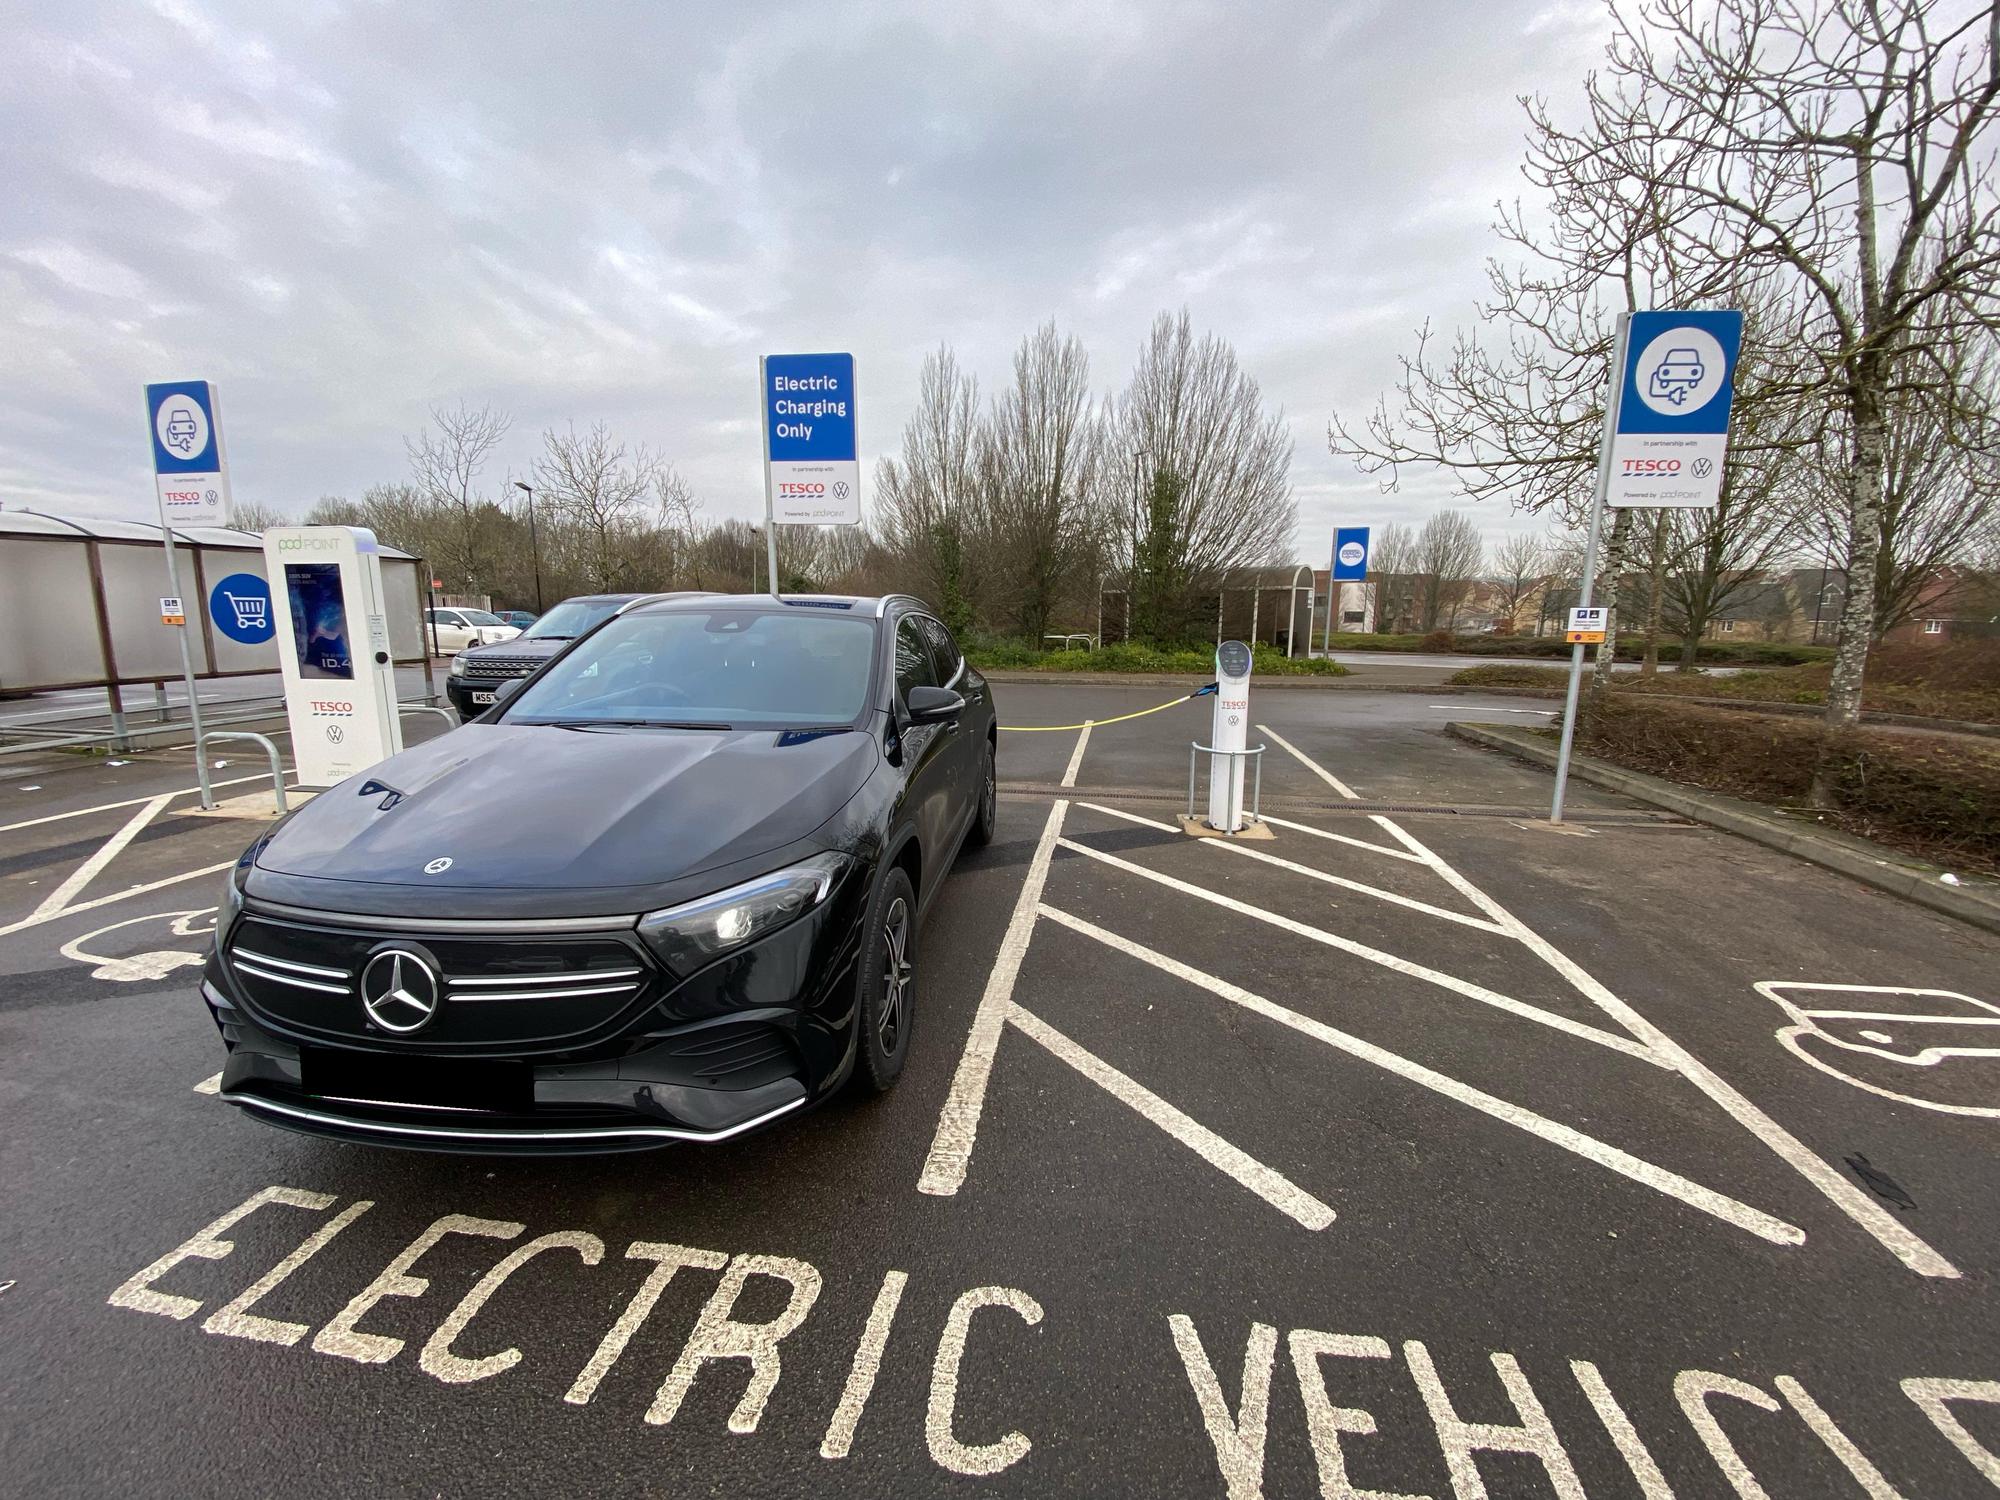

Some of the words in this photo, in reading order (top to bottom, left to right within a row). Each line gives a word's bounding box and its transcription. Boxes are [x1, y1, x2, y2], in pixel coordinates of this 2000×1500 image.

[774, 375, 838, 391] Electric
[775, 399, 846, 417] Charging
[776, 423, 813, 440] Only
[1622, 459, 1682, 472] TESCO
[779, 483, 825, 494] TESCO
[165, 491, 200, 501] TESCO
[310, 701, 353, 712] TESCO
[107, 1184, 1045, 1477] ELECTRIC
